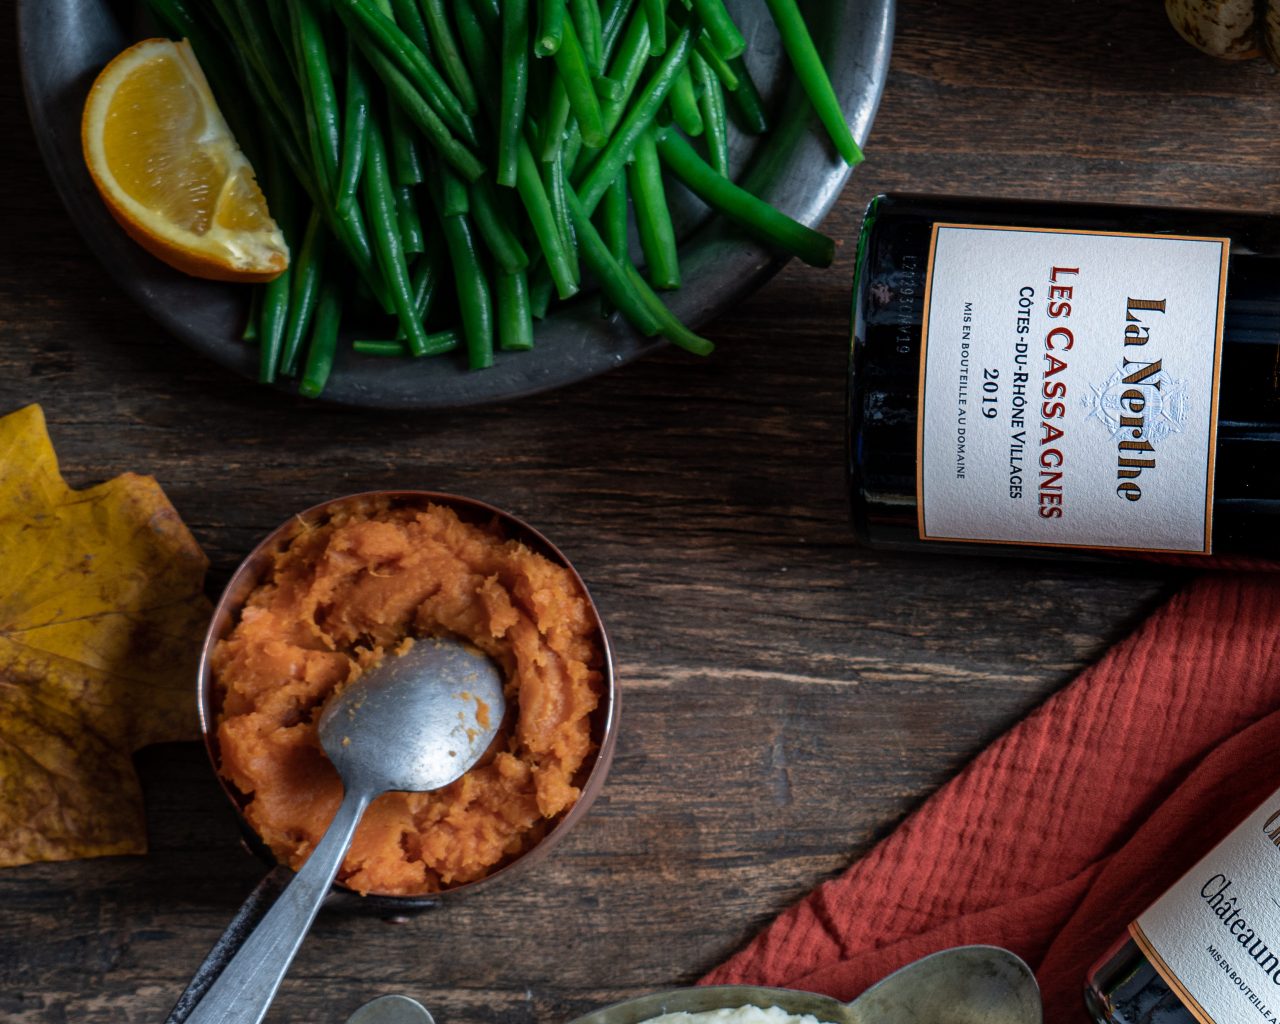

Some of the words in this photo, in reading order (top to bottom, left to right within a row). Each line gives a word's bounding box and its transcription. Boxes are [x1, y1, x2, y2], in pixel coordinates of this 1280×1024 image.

[963, 302, 973, 323] MIS
[1047, 267, 1079, 318] LES
[961, 326, 971, 340] EN
[1124, 297, 1167, 346] La
[958, 343, 970, 405] BOUTEILLE
[982, 368, 1000, 419] 2019
[957, 408, 967, 425] AU
[1036, 327, 1075, 518] CASSAGNES
[1116, 357, 1163, 504] Nerthe
[956, 428, 967, 480] DOMAINE
[1010, 431, 1027, 500] VILLAGES
[1206, 944, 1223, 962] MIS
[1219, 960, 1233, 974] EN
[1229, 971, 1272, 1019] BOUTEILLE
